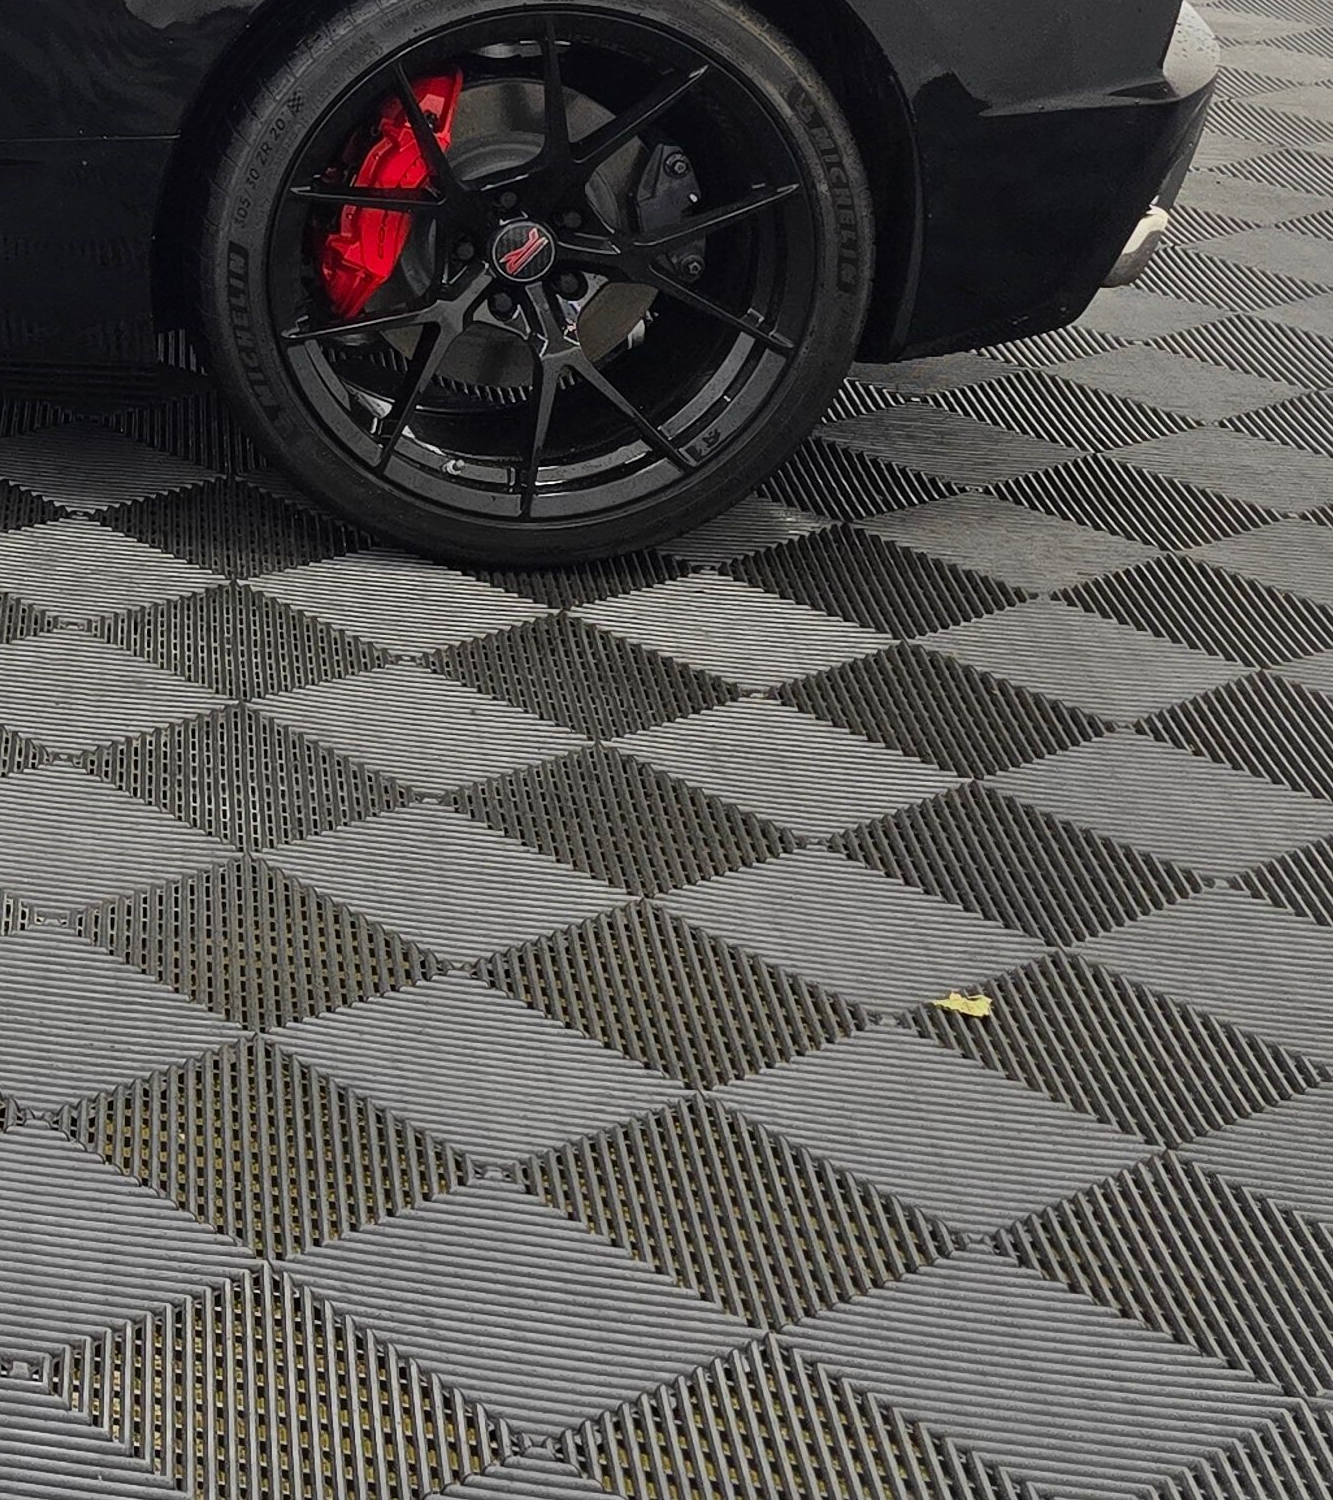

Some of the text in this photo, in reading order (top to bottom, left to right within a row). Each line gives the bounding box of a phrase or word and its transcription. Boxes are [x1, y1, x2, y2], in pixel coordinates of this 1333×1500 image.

[255, 141, 272, 166] ZR
[269, 118, 286, 141] 20
[228, 251, 279, 407] MICHELIN
